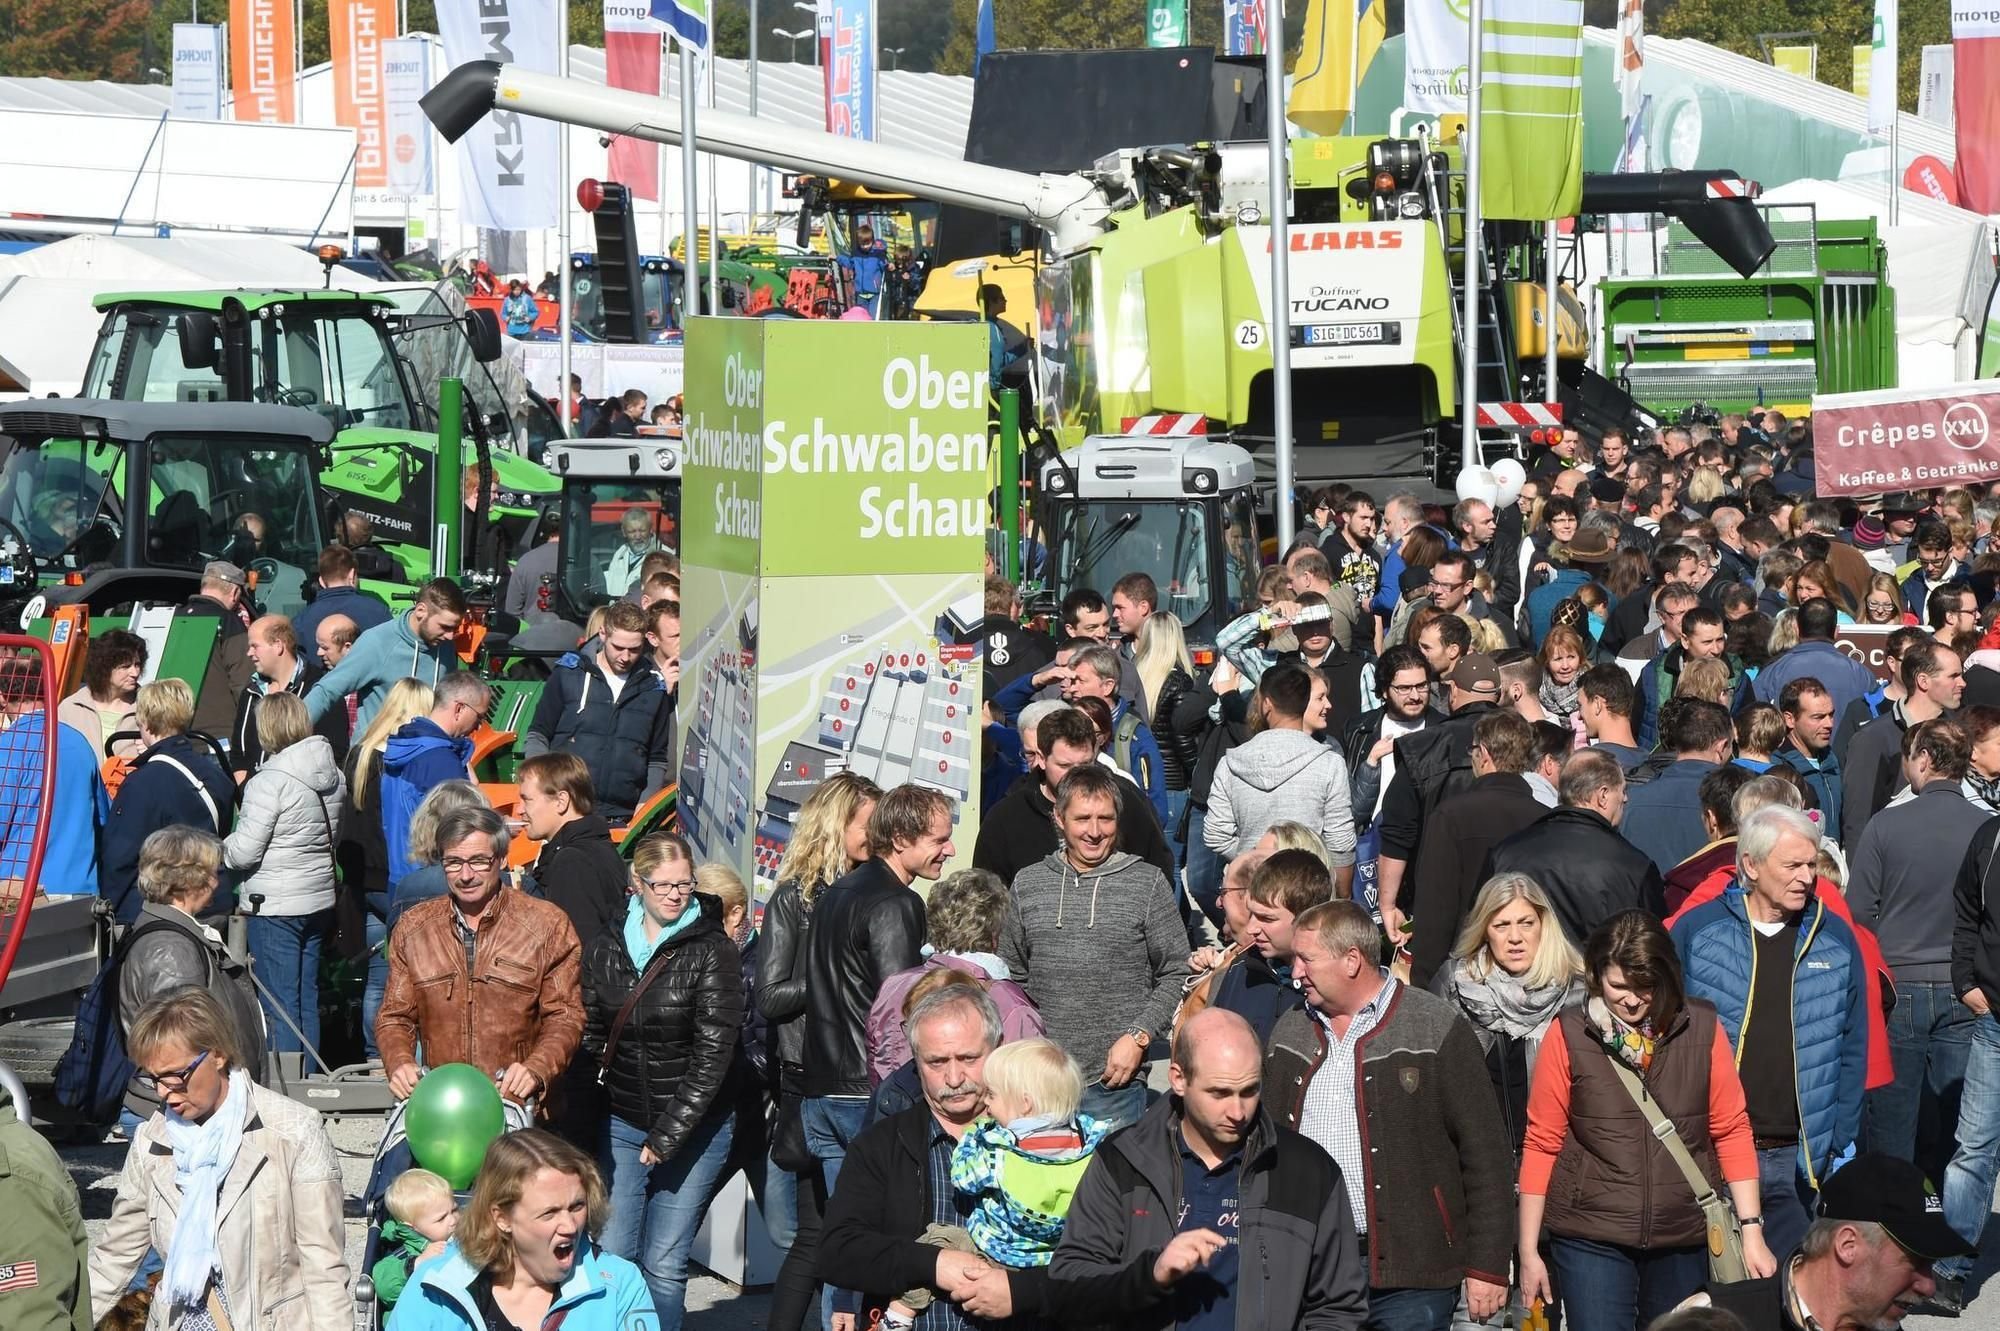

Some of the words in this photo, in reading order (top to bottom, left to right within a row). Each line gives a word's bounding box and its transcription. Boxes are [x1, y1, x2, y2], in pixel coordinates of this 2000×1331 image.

[1266, 230, 1403, 254] LAAS
[1291, 297, 1389, 313] TUCANO
[1311, 286, 1361, 298] Duffner
[1241, 326, 1258, 345] 25
[724, 352, 762, 409] Ober
[882, 354, 989, 410] Ober
[682, 412, 760, 473] Schwaben
[763, 416, 987, 475] Schwaben
[1837, 421, 1937, 449] Crêpes
[1943, 419, 1984, 437] XXL
[1838, 471, 1897, 487] Kaffee
[1900, 466, 1912, 481] &
[1915, 458, 1999, 479] Getränke
[715, 481, 760, 540] Schau
[859, 482, 985, 539] Schau
